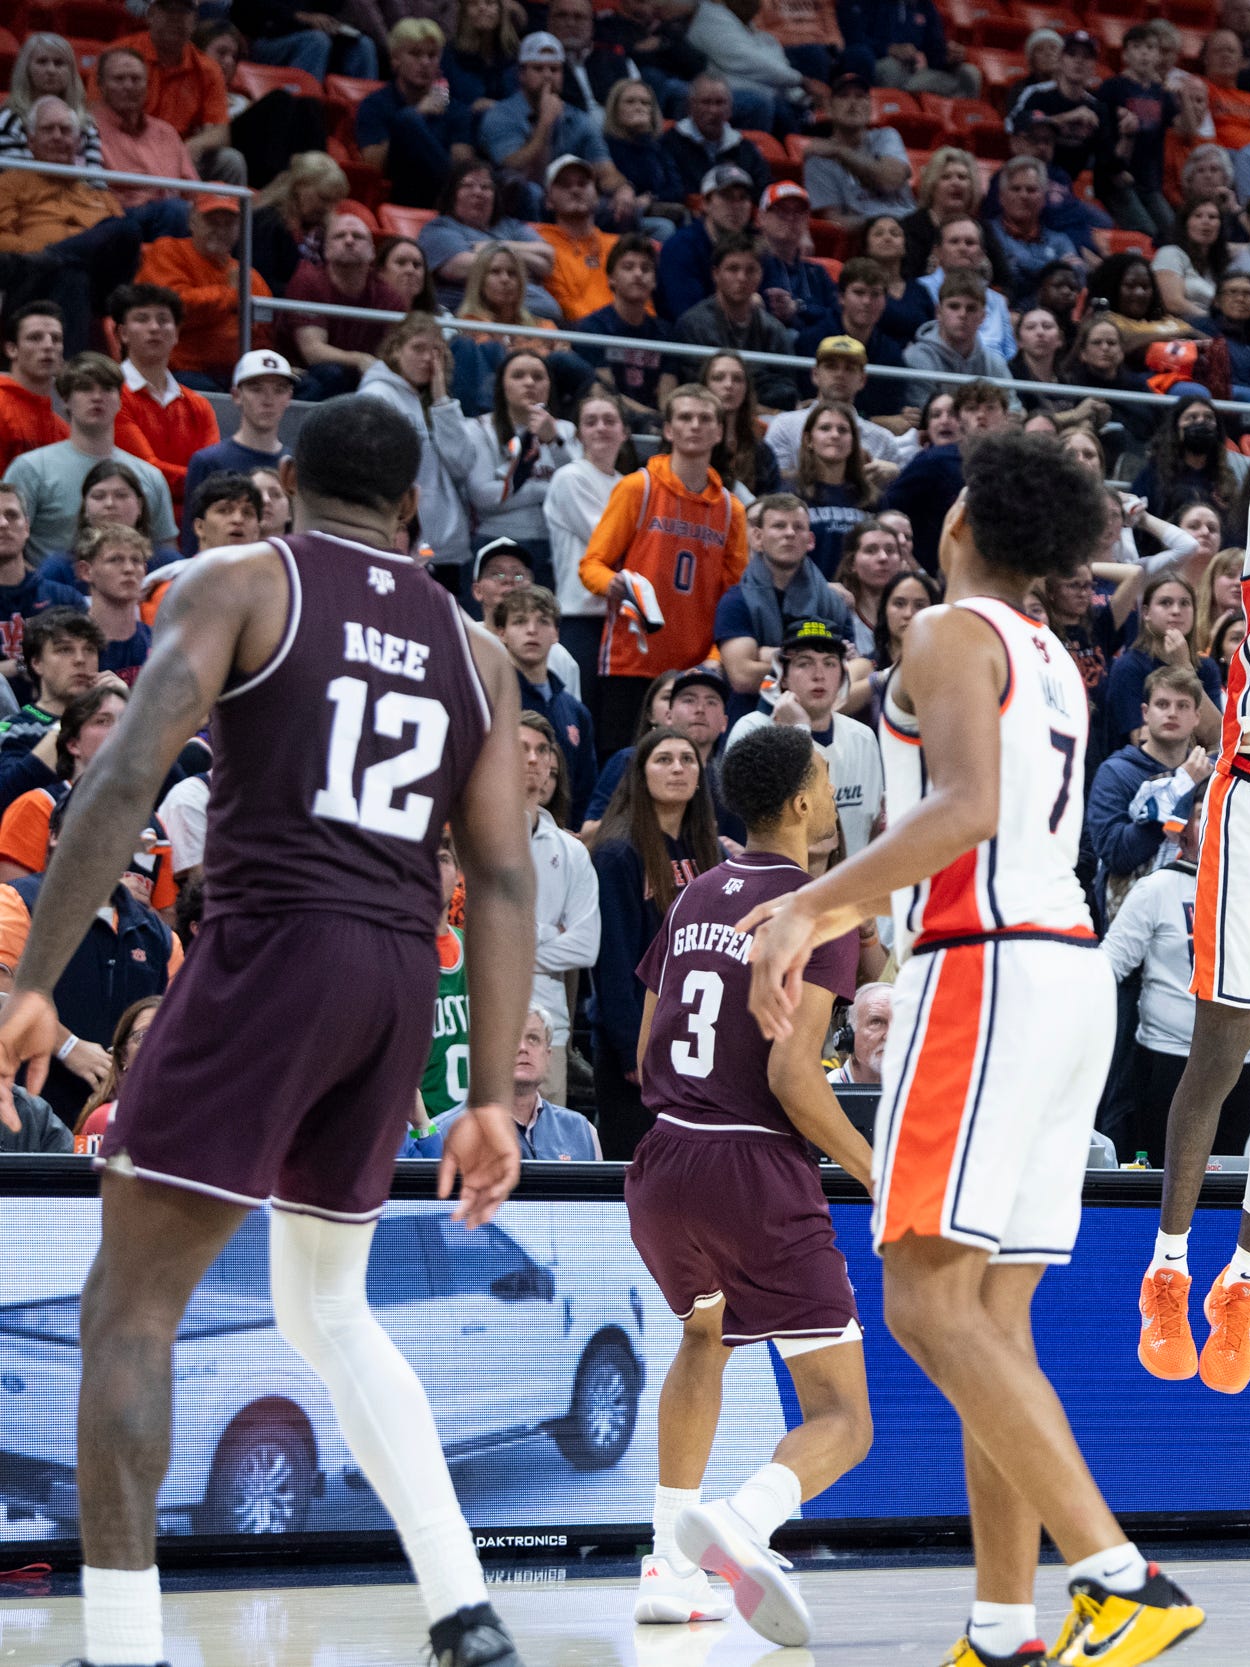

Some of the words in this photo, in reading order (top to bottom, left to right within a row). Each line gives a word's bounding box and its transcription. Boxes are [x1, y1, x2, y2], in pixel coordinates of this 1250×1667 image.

[648, 516, 726, 548] AUBURN
[673, 550, 697, 595] 0
[343, 621, 430, 682] AGEE
[312, 675, 450, 842] 12
[1048, 725, 1077, 835] 7
[673, 922, 754, 965] GRIFFEN
[670, 969, 724, 1079] 3
[476, 1535, 568, 1547] DAKTRONICS
